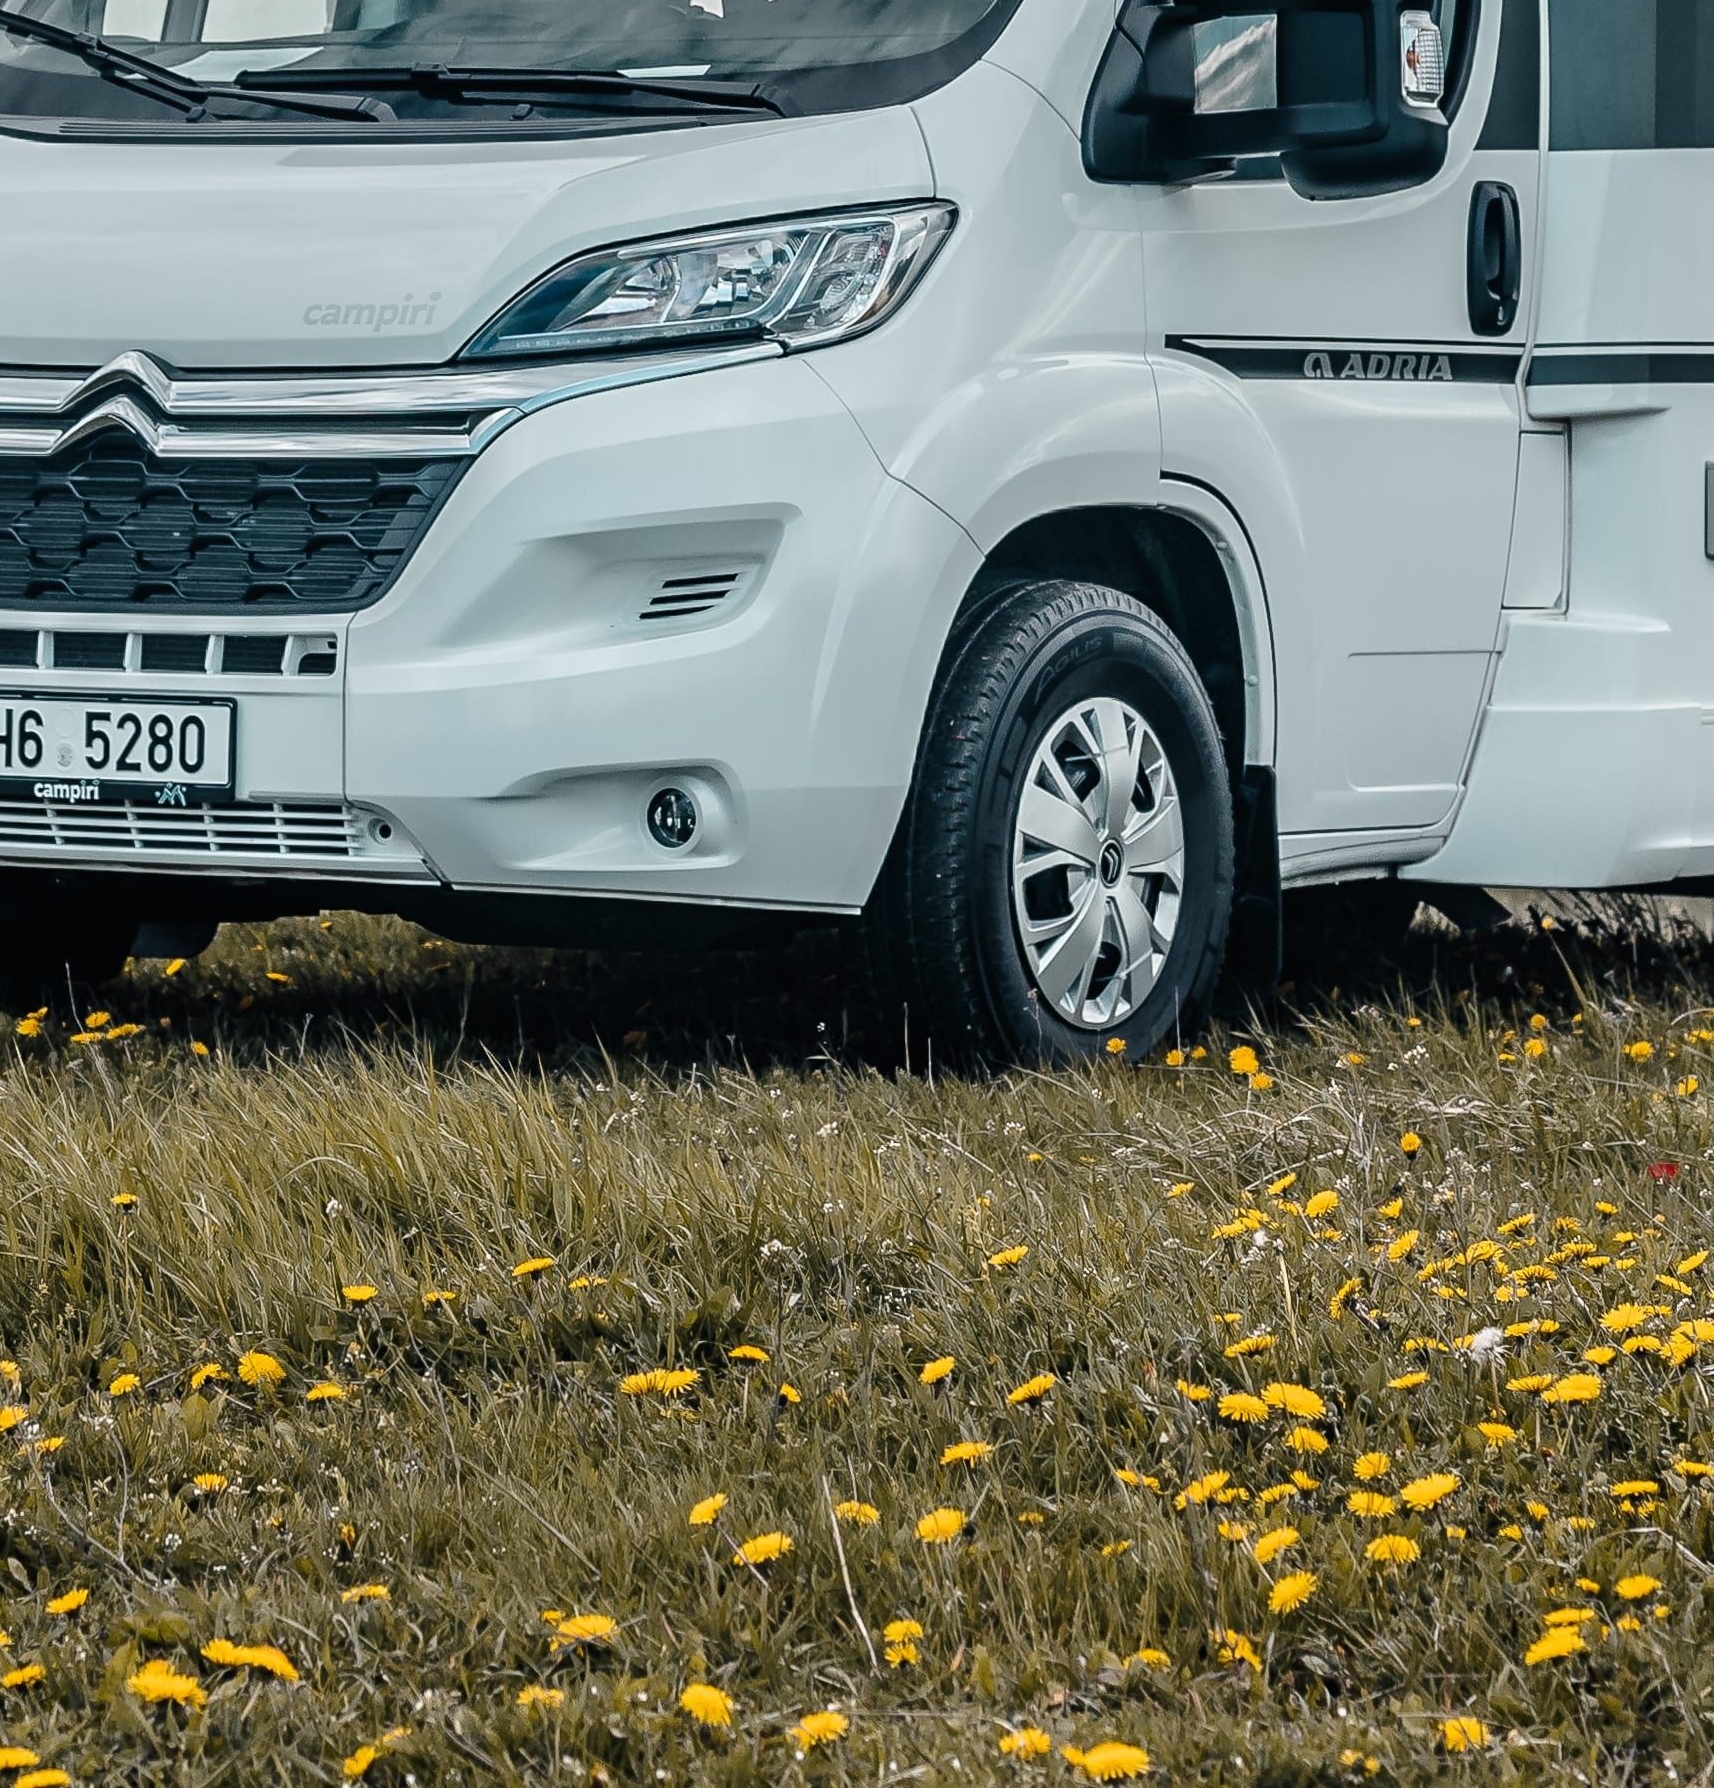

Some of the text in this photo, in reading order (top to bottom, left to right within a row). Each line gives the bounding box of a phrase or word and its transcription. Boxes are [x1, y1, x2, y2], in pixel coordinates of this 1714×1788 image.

[302, 291, 442, 332] campiri
[1339, 353, 1453, 380] ADRIA
[84, 710, 206, 774] 5280
[33, 778, 100, 803] campiri
